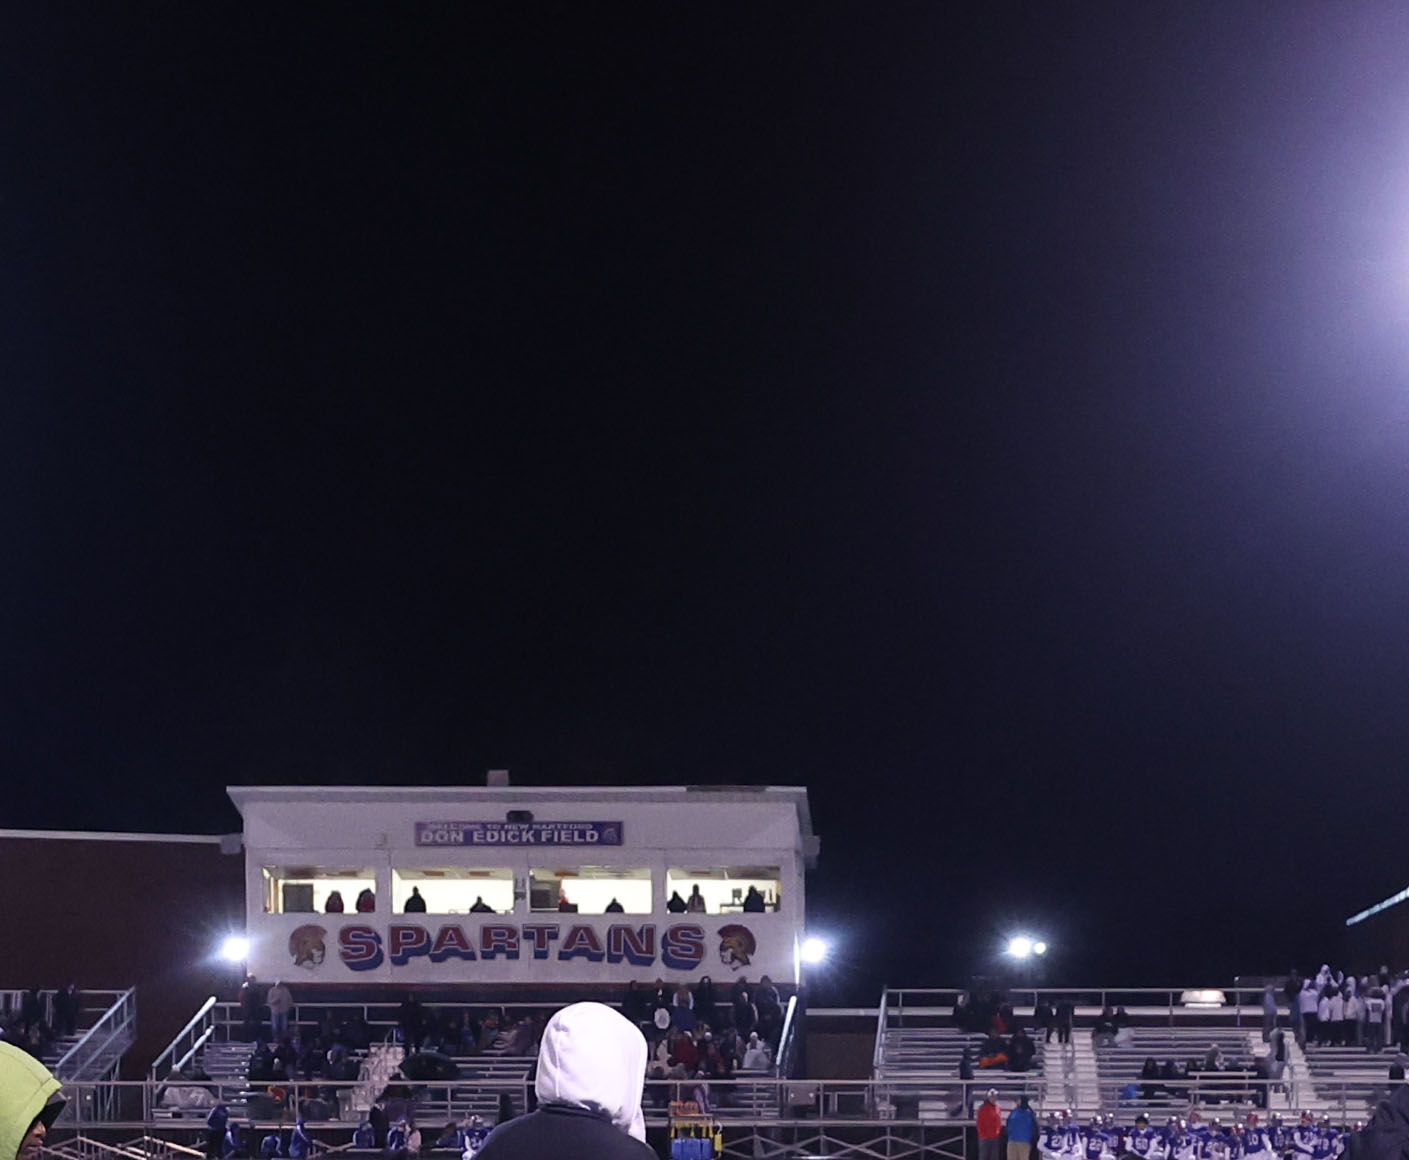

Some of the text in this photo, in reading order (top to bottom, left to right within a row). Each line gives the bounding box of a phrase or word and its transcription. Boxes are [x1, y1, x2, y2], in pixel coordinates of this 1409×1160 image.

[420, 830, 599, 843] DON EDICK FIELD
[338, 922, 707, 972] SPARTANS
